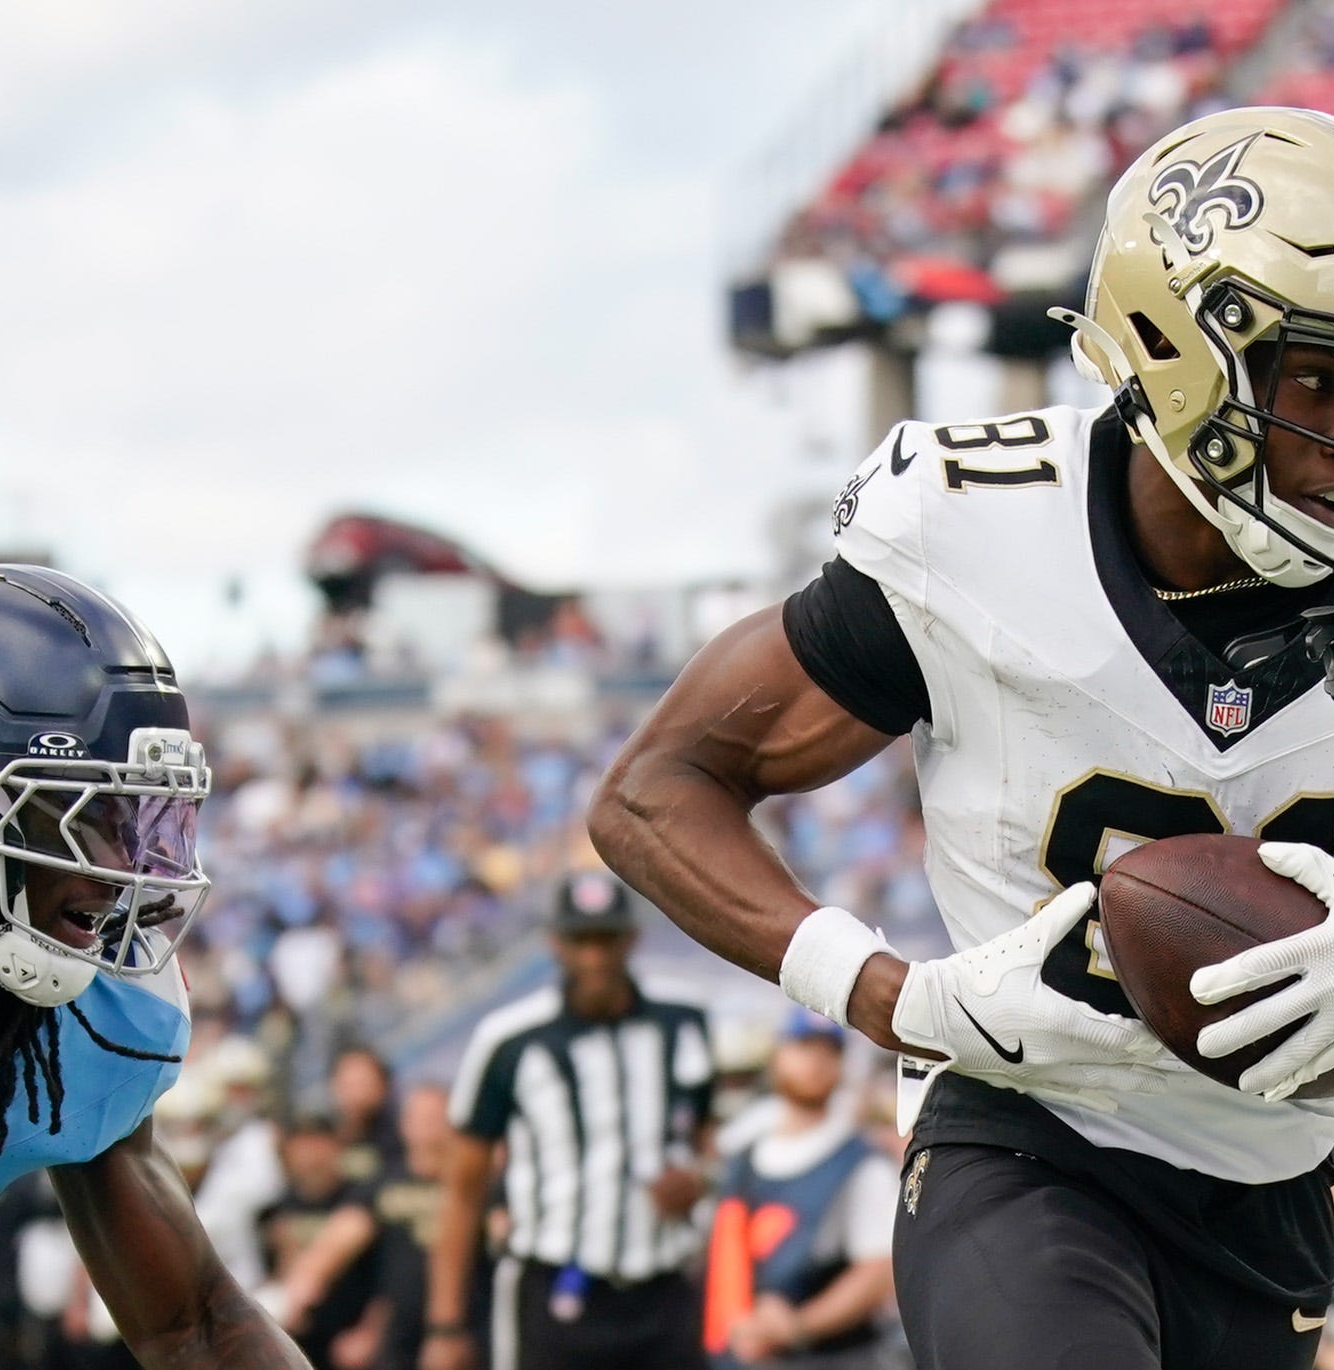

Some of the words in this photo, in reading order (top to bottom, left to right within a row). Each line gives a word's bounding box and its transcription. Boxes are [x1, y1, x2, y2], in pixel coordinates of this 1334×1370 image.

[932, 414, 1063, 494] 81
[1213, 705, 1244, 728] NFL
[29, 746, 85, 758] OAKLEY
